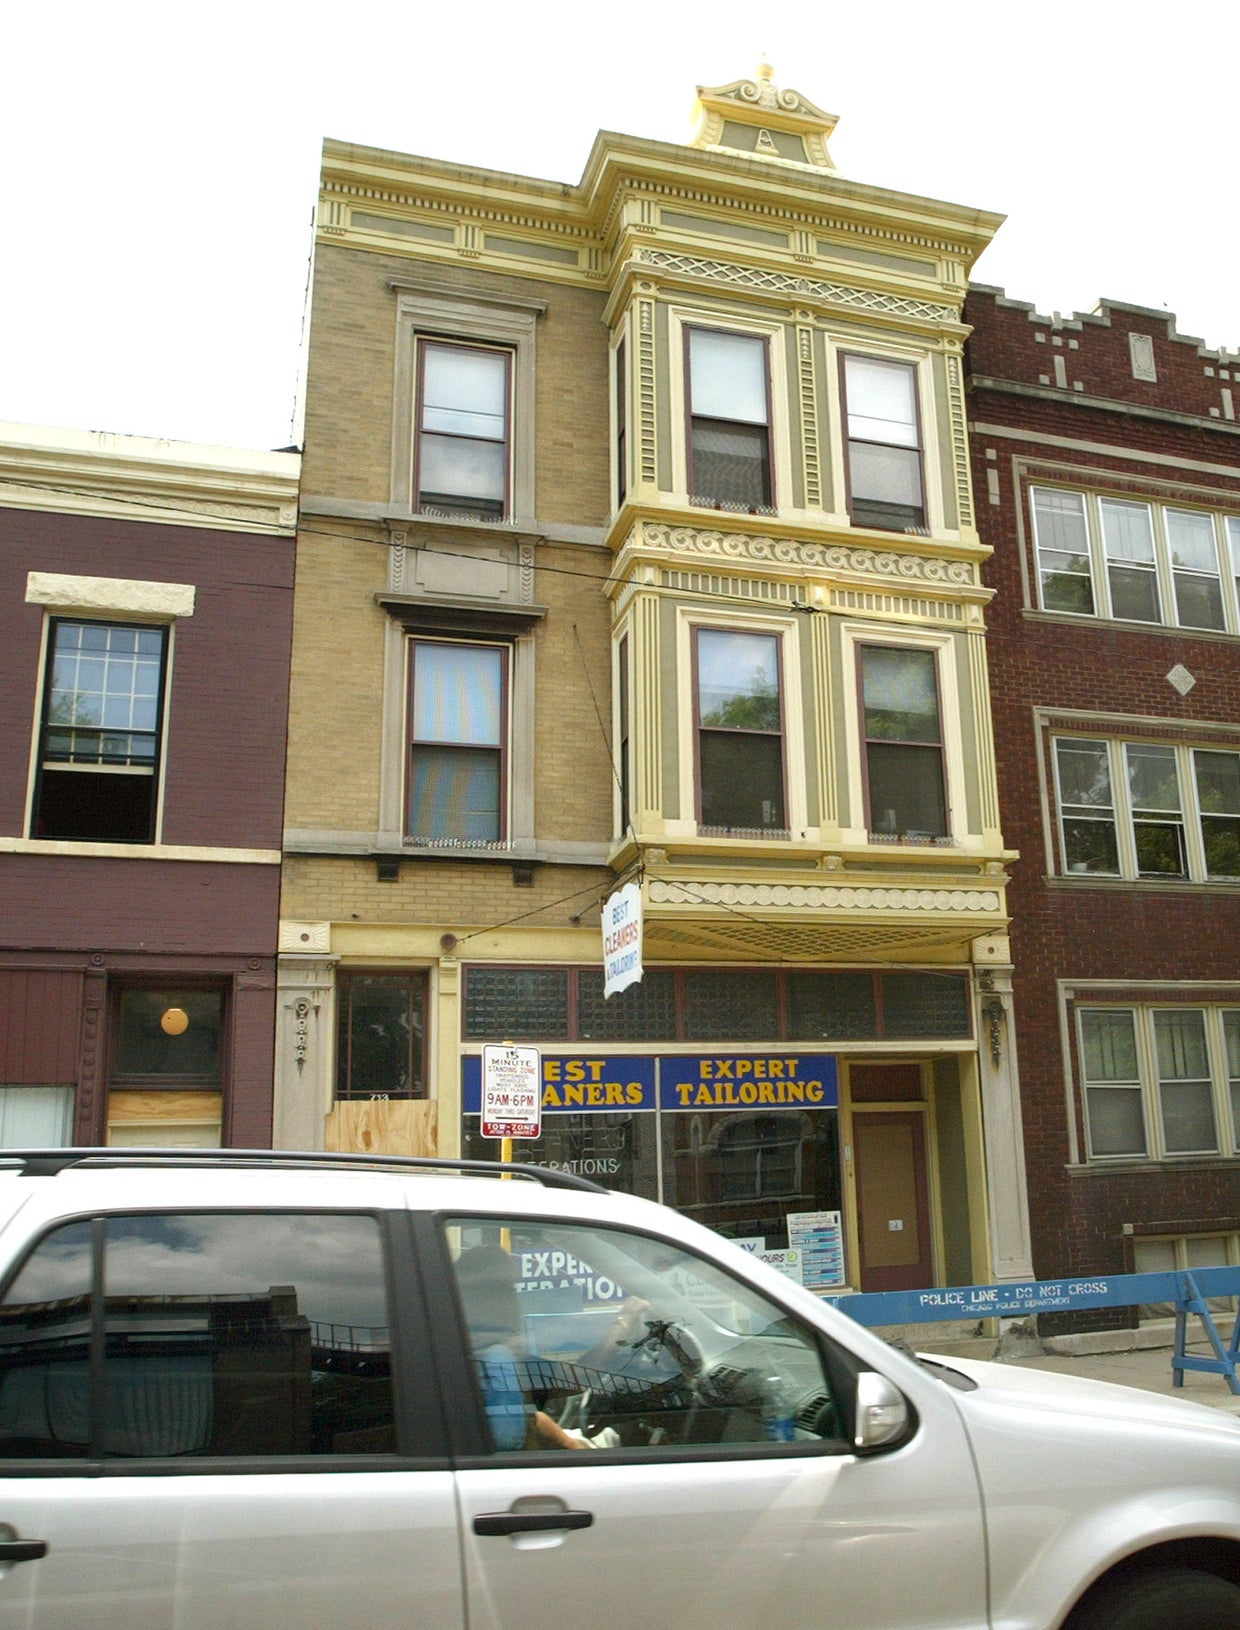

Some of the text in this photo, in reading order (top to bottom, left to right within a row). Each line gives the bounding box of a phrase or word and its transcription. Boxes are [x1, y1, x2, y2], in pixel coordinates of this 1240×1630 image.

[612, 900, 629, 925] BEST
[606, 919, 638, 956] CLEANERS
[491, 1058, 532, 1067] MINUTE
[506, 1051, 519, 1059] 15
[488, 1065, 535, 1075] STANDING ZONE
[543, 1060, 606, 1082] EST
[700, 1059, 799, 1079] EXPERT
[370, 1093, 390, 1101] 713
[541, 1082, 644, 1107] ANERS
[675, 1080, 824, 1105] TAILORING
[487, 1122, 536, 1131] TOW-ZONE
[920, 1292, 965, 1306] POLICE
[971, 1289, 999, 1303] LINE
[1016, 1287, 1034, 1300] DO
[1039, 1284, 1063, 1298] NOT
[1068, 1281, 1108, 1296] CROSS
[961, 1296, 1070, 1313] CHICAGO POLICE DEPARTMENT
